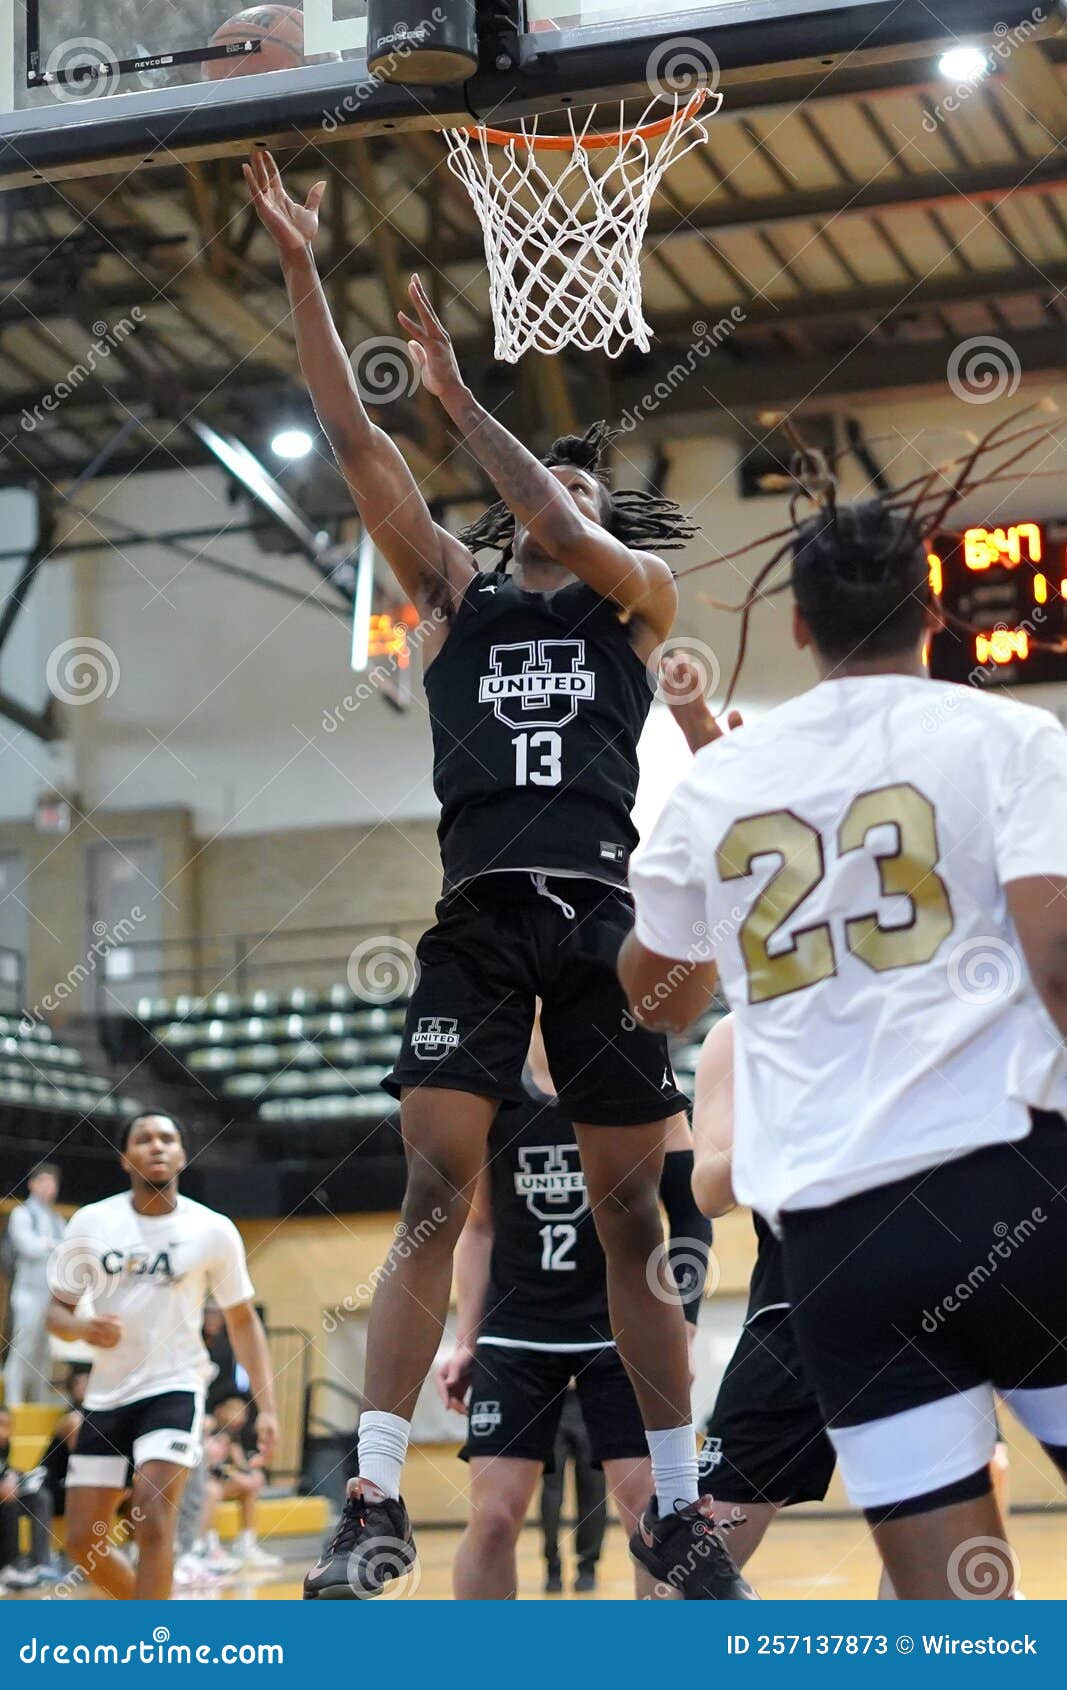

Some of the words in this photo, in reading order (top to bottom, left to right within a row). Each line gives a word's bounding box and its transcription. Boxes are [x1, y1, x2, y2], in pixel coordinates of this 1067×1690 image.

[488, 676, 586, 694] UNITED
[511, 730, 562, 786] 13
[715, 782, 954, 1005] 23
[414, 1034, 455, 1043] UNITED
[522, 1175, 585, 1188] UNITE
[539, 1224, 577, 1271] 12
